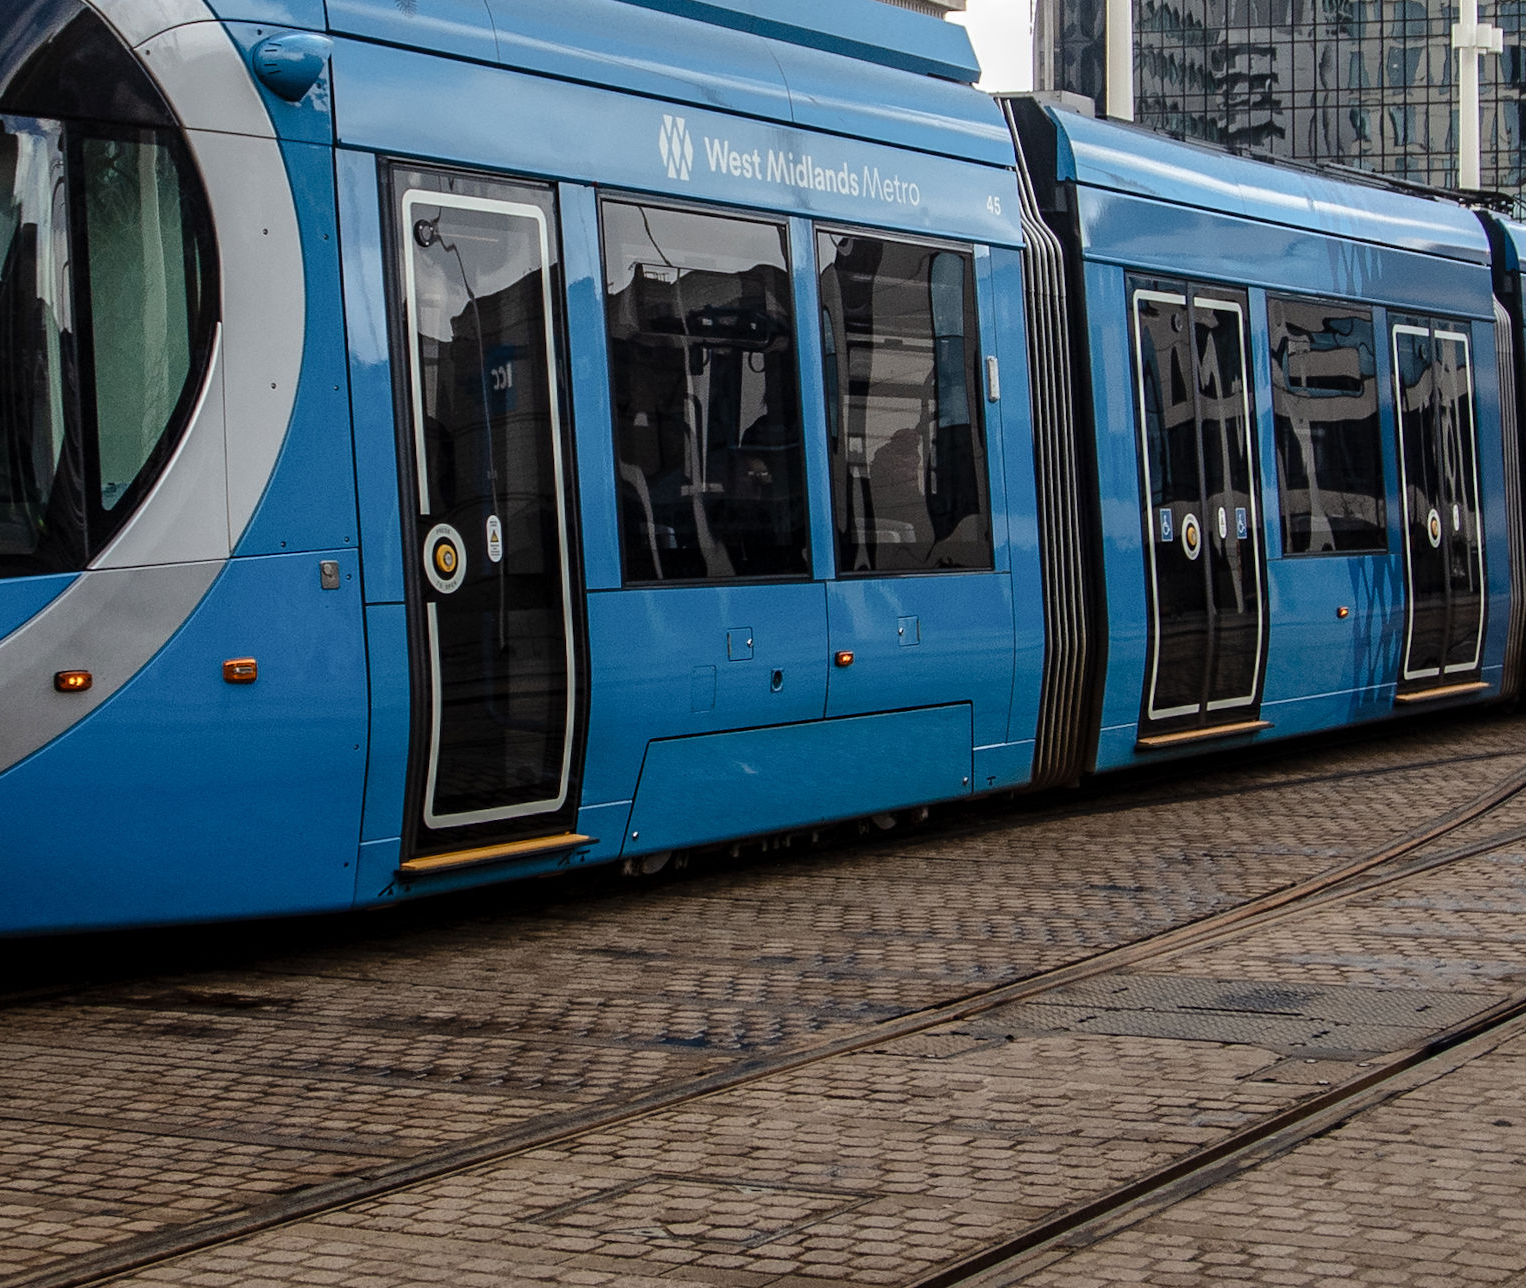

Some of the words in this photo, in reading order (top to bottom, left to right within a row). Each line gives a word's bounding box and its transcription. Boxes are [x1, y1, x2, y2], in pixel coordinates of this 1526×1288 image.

[704, 137, 762, 180] West
[767, 149, 859, 196] Midlands
[862, 166, 920, 206] Metro
[986, 195, 1001, 215] 45
